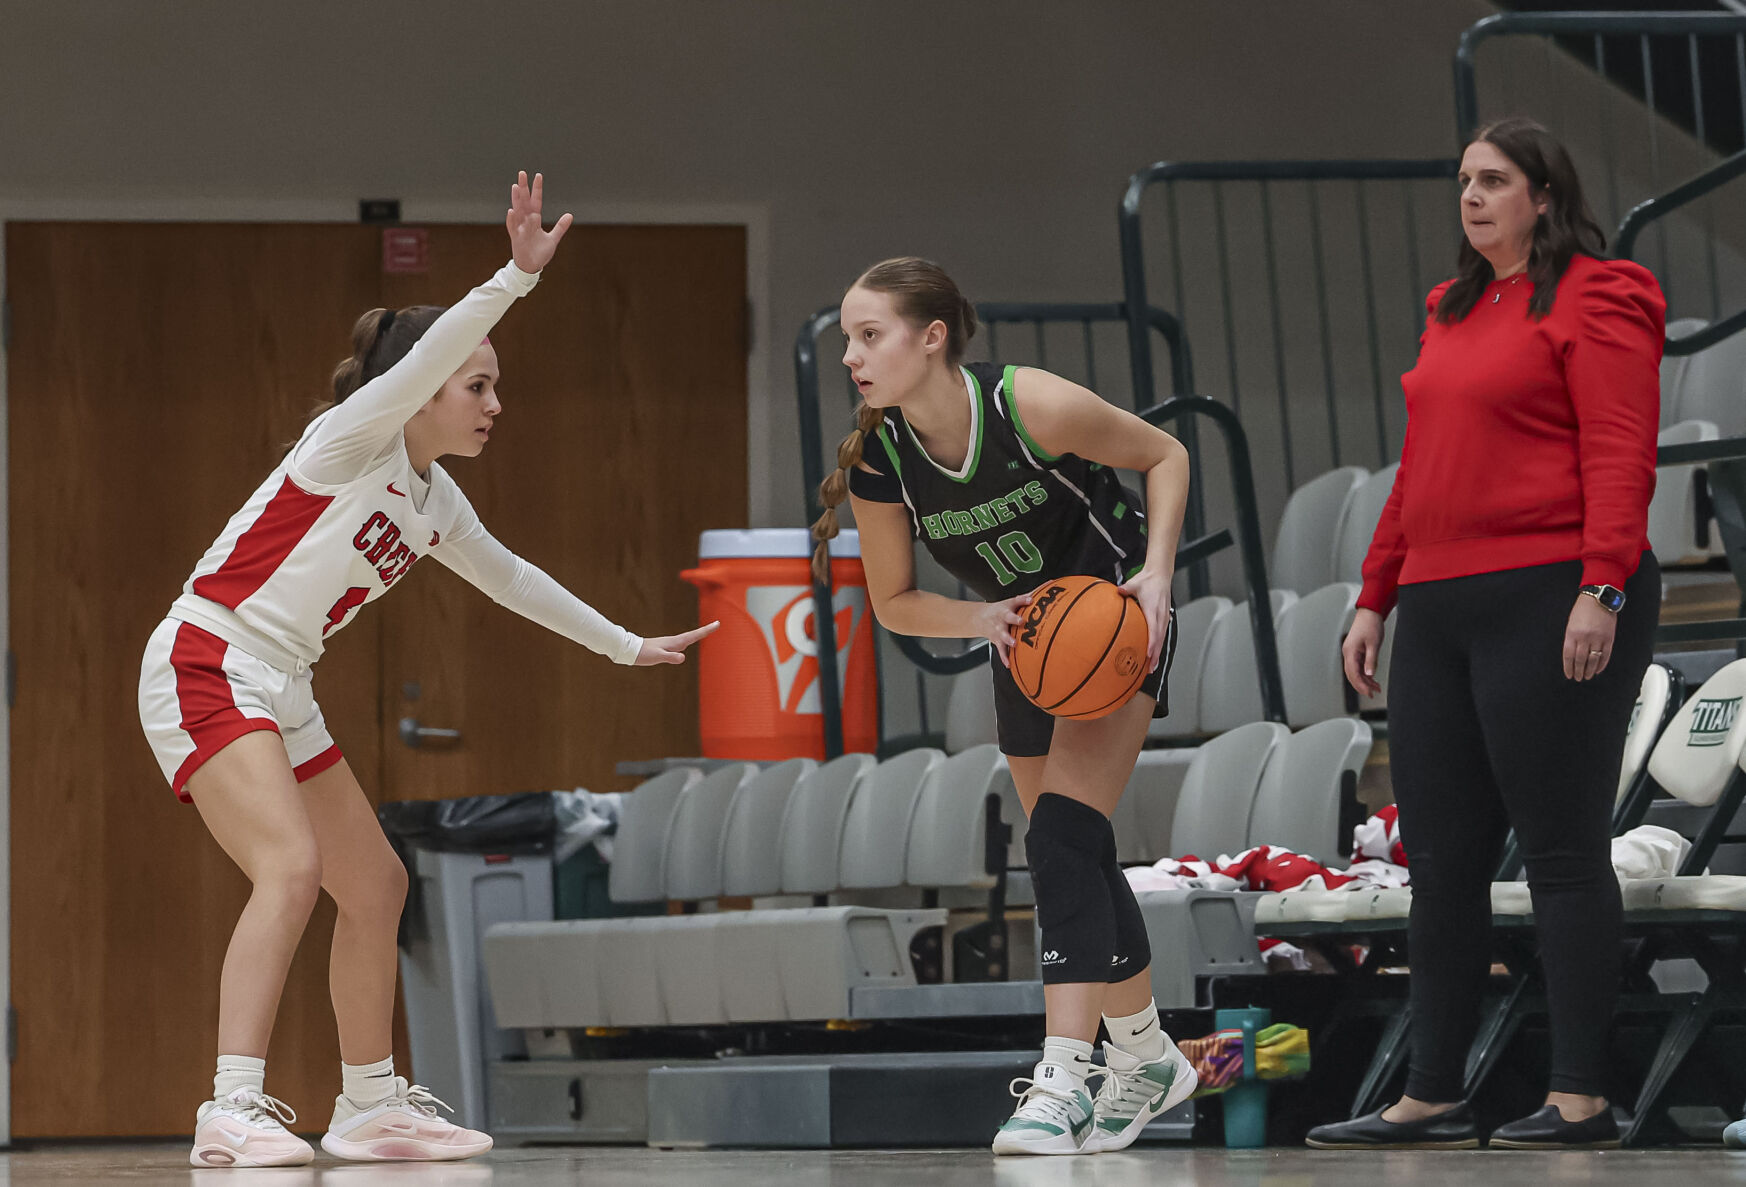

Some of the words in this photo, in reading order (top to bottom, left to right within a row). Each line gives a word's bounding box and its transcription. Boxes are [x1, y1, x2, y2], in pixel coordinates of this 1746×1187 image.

[921, 480, 1048, 540] HORNETS
[975, 530, 1044, 587] 10
[1021, 585, 1067, 648] NCAA
